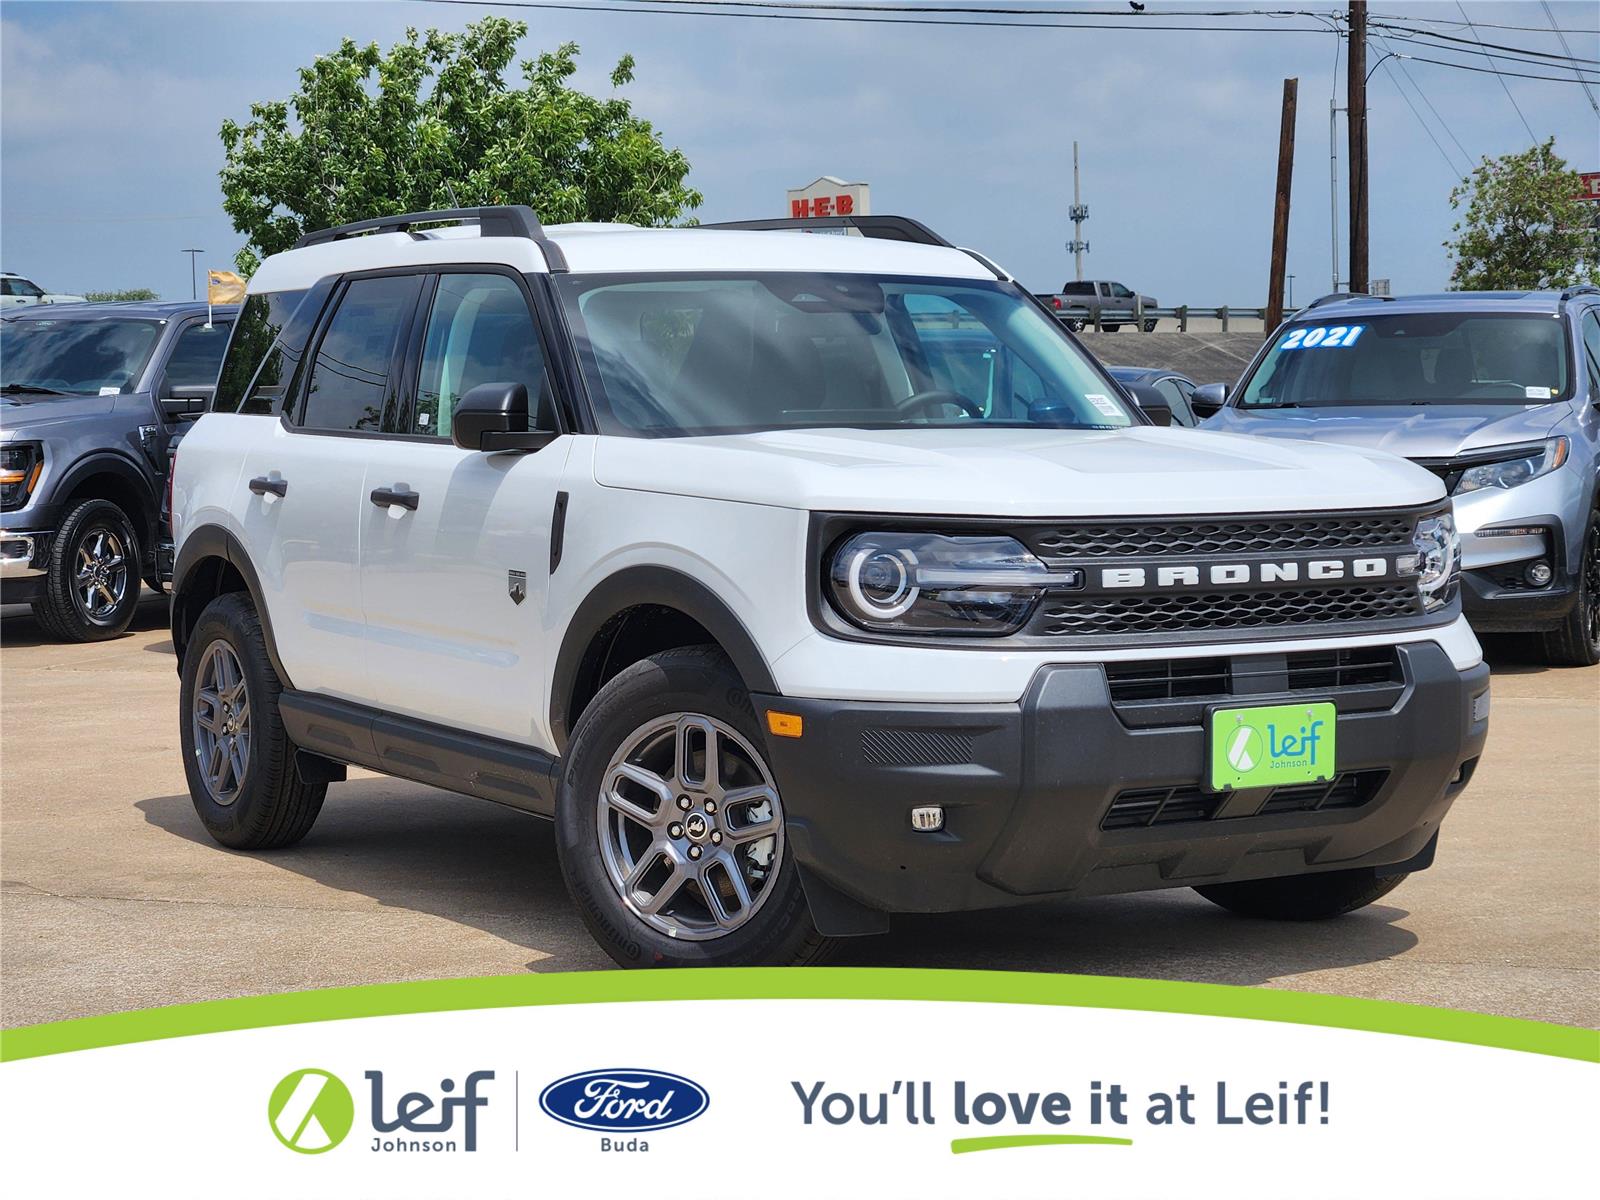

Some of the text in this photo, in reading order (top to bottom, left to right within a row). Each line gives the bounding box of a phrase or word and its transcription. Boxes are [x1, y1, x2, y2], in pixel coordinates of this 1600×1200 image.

[1280, 326, 1363, 349] 2021
[1101, 558, 1387, 588] BRONCO
[1269, 759, 1308, 769] Johnson
